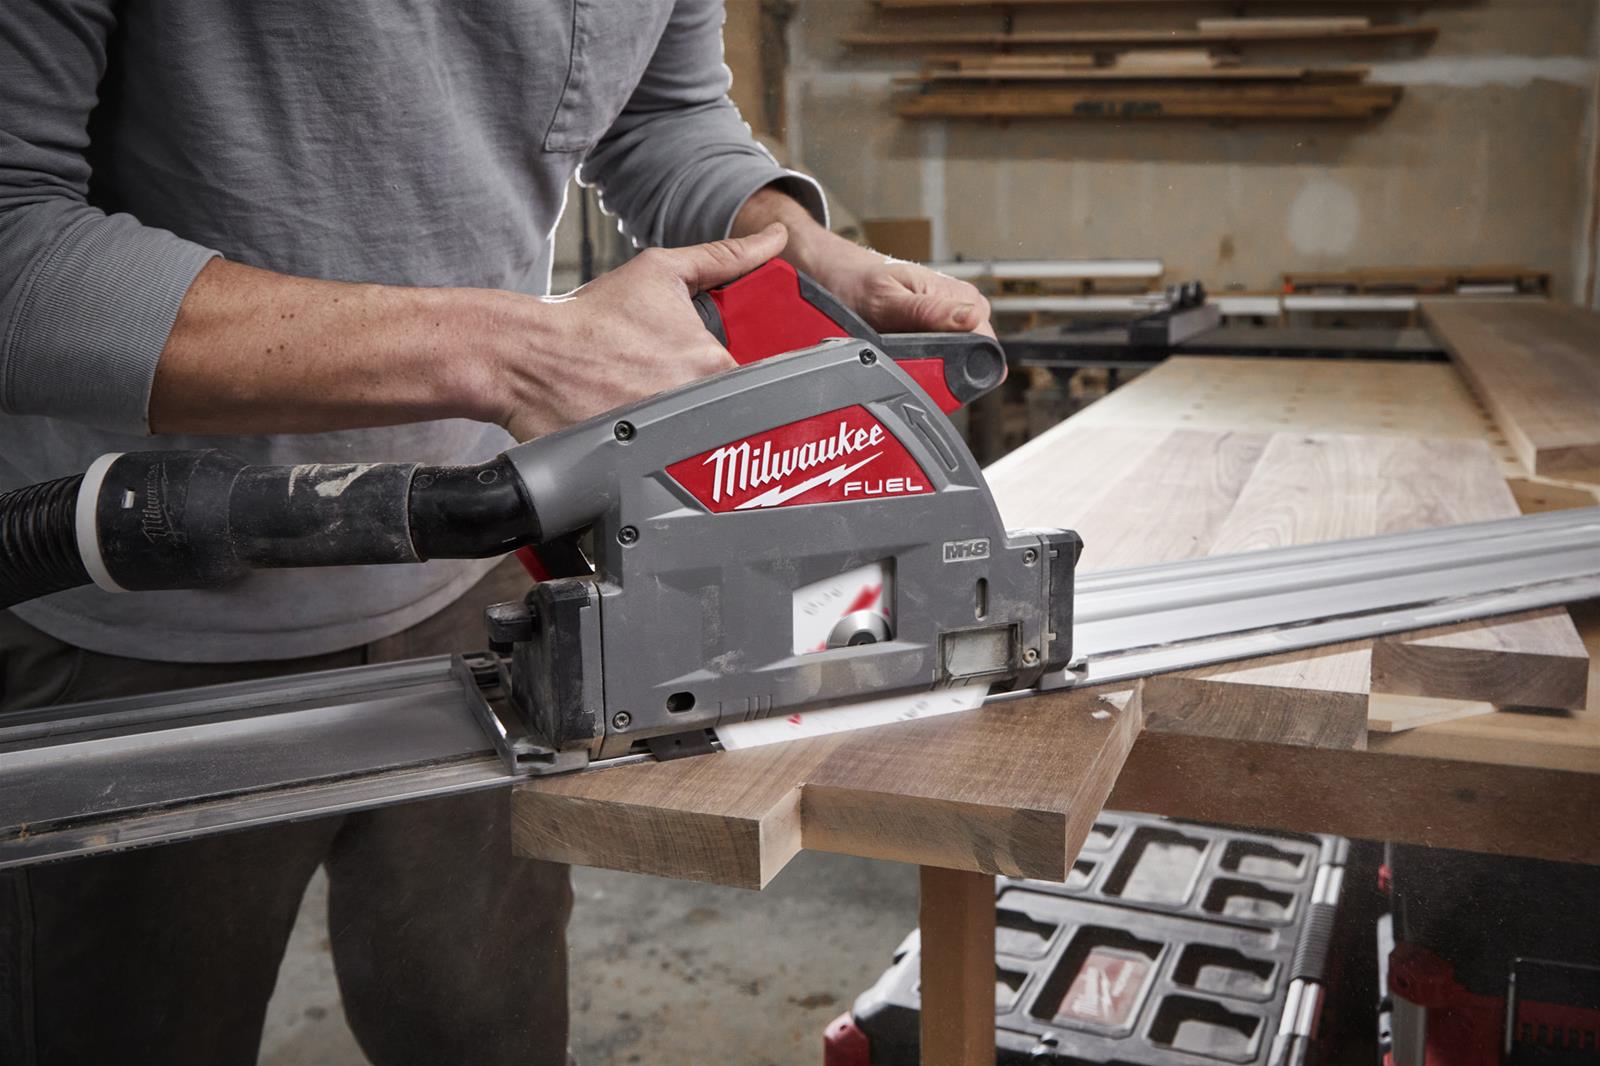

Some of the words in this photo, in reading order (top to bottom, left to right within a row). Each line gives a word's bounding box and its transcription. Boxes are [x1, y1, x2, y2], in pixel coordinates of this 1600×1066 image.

[702, 421, 886, 503] Milwaukee
[844, 477, 924, 496] FUEL
[945, 541, 988, 560] M18
